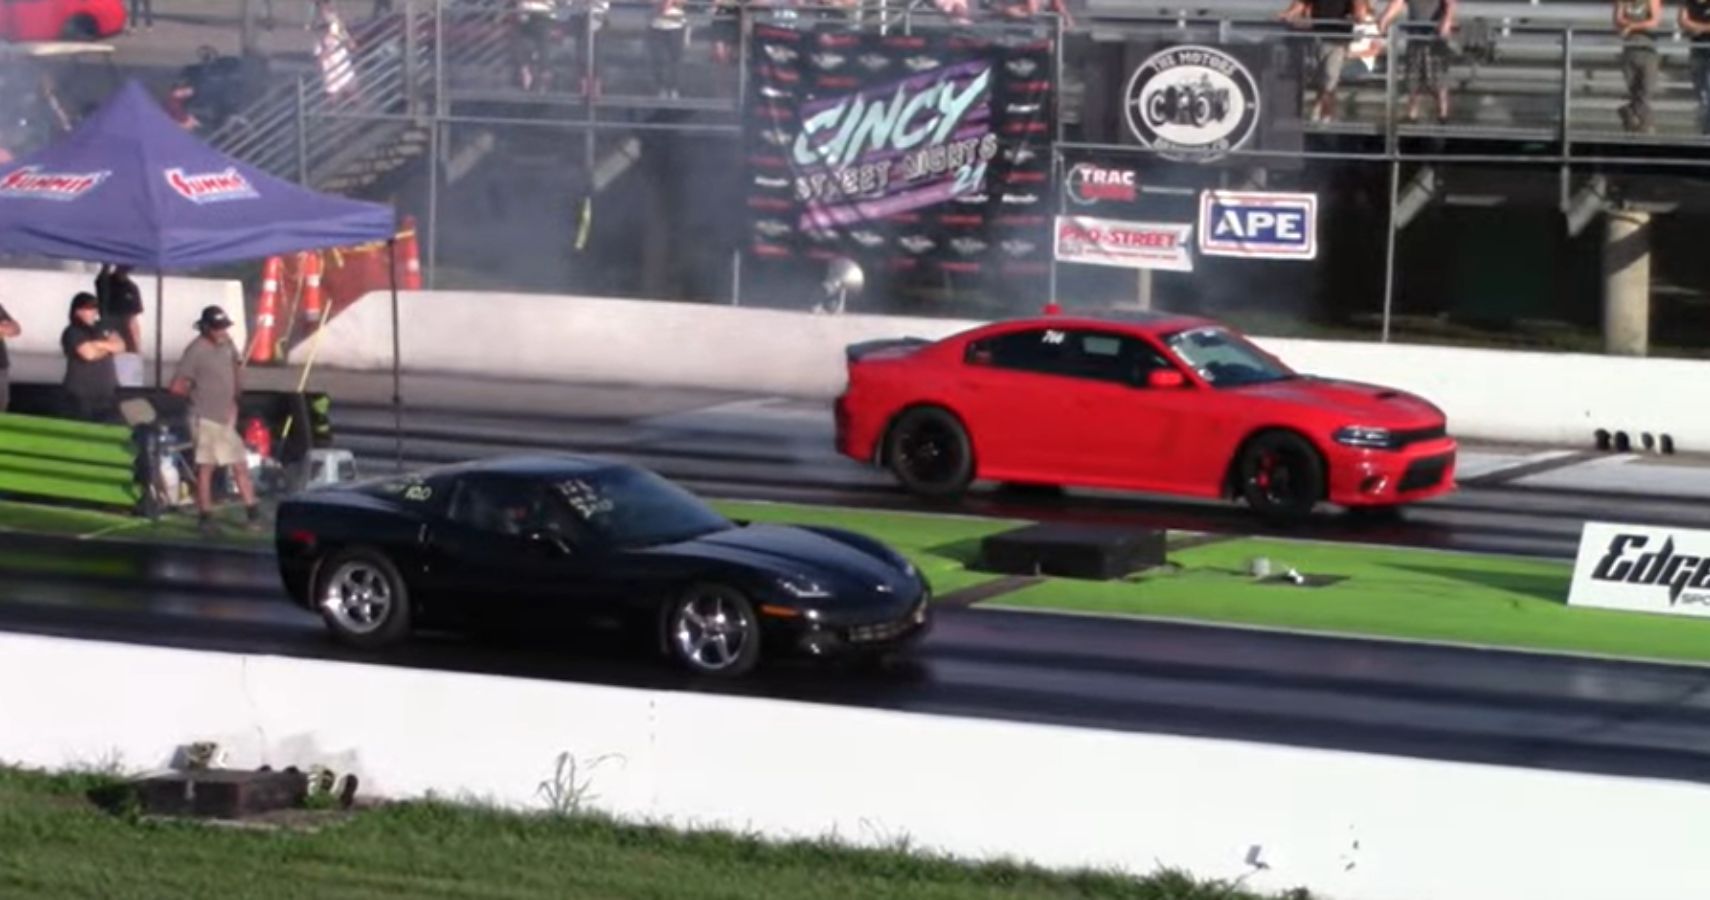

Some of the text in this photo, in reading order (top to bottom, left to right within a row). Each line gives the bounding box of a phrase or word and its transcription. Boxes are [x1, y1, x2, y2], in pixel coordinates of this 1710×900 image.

[793, 67, 991, 166] CINCY
[949, 163, 988, 196] 21
[1080, 168, 1136, 186] TRAC
[1215, 209, 1302, 239] APE
